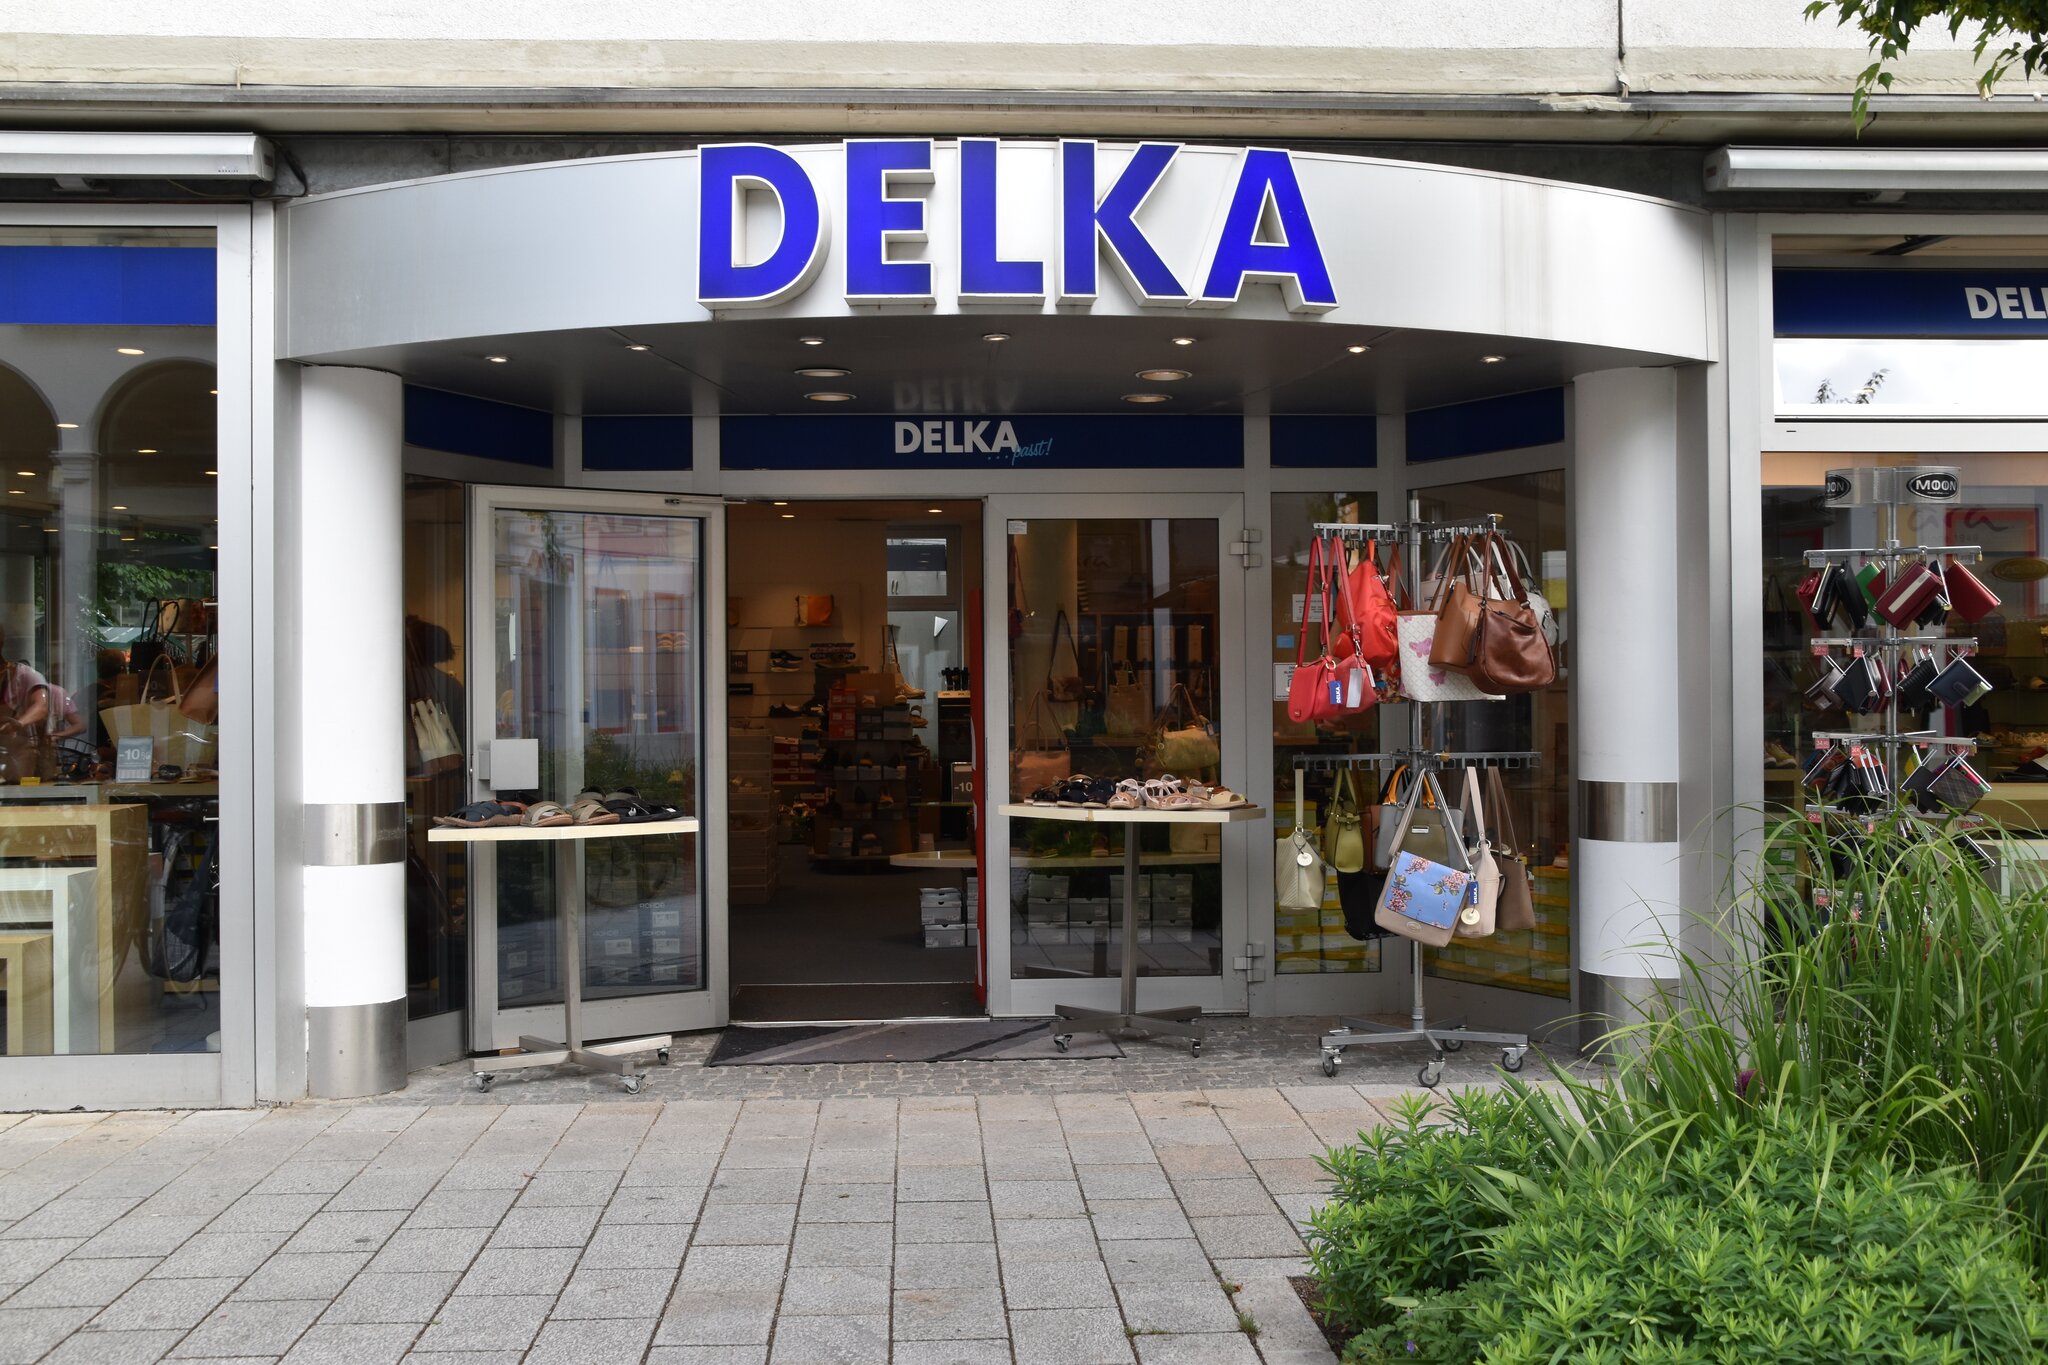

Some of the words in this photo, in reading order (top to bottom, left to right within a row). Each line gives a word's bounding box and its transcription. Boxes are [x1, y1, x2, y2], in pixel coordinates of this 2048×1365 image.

[697, 137, 1339, 314] DELKA
[1965, 287, 2048, 319] DEL
[895, 420, 1020, 453] DELKA
[1916, 479, 1956, 491] MOON
